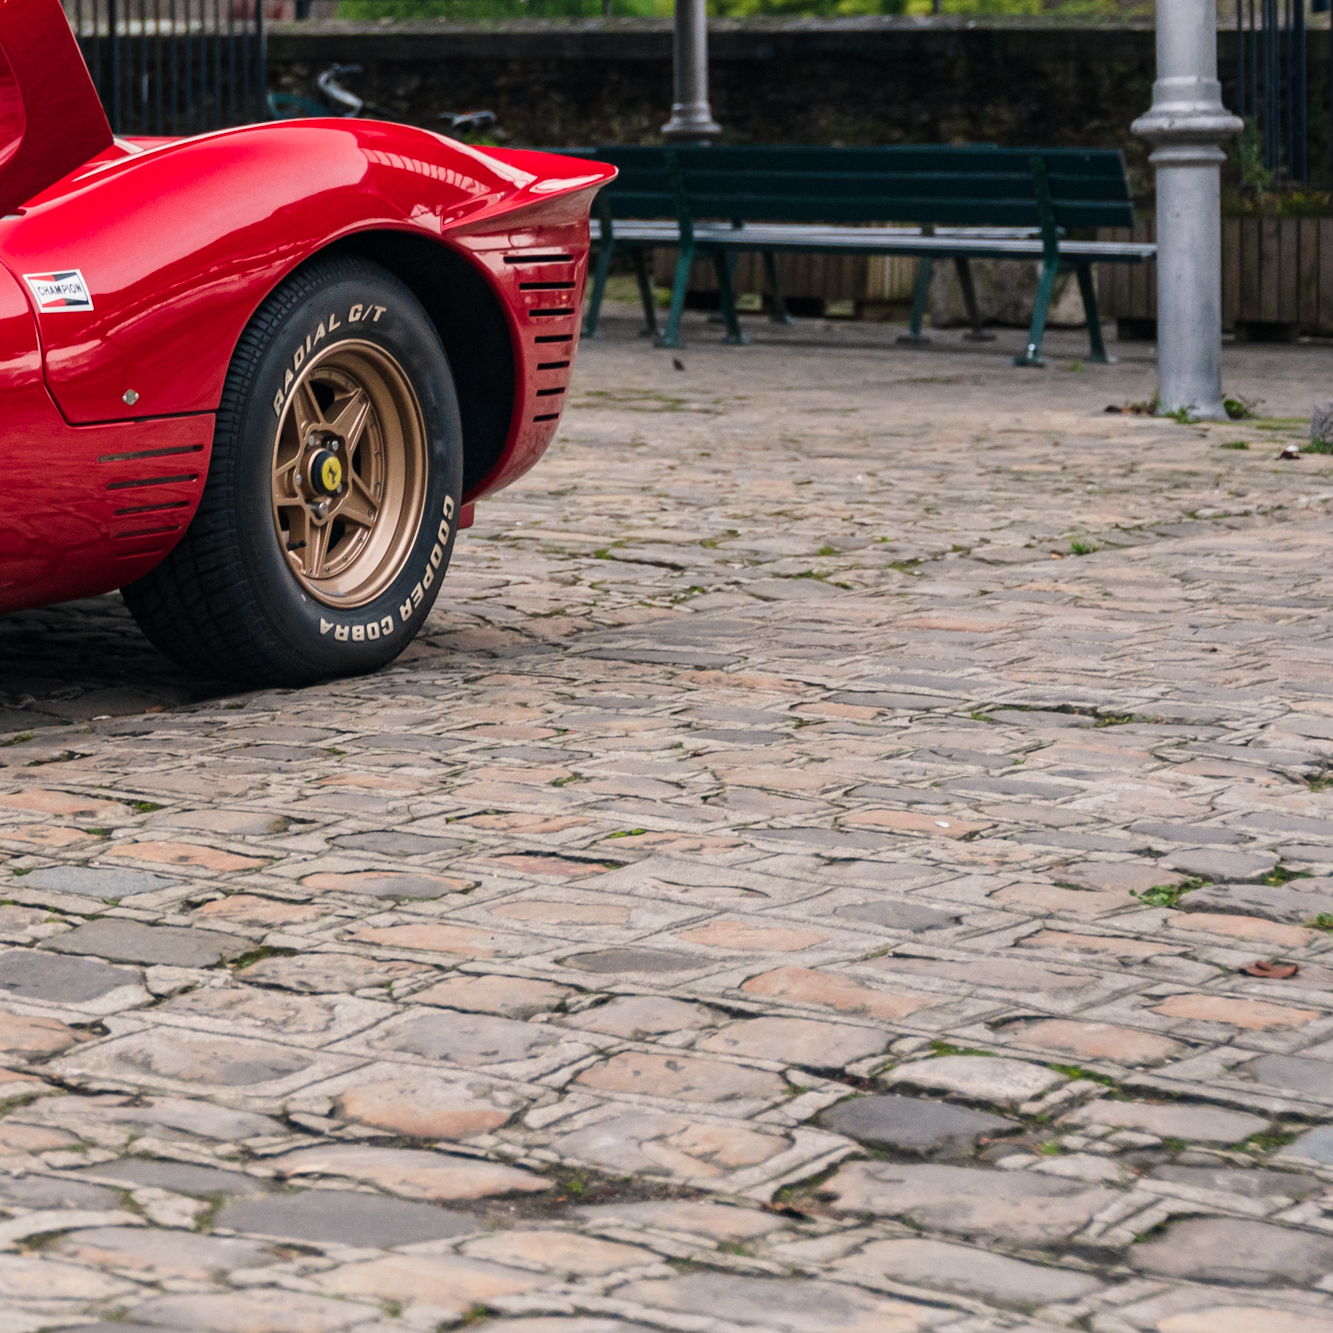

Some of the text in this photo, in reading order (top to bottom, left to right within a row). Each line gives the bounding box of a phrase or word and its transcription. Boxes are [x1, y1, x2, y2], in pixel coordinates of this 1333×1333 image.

[37, 283, 83, 296] CHAMPION
[274, 303, 386, 417] RADIAL G/T
[320, 494, 455, 642] COOPER COBRA
